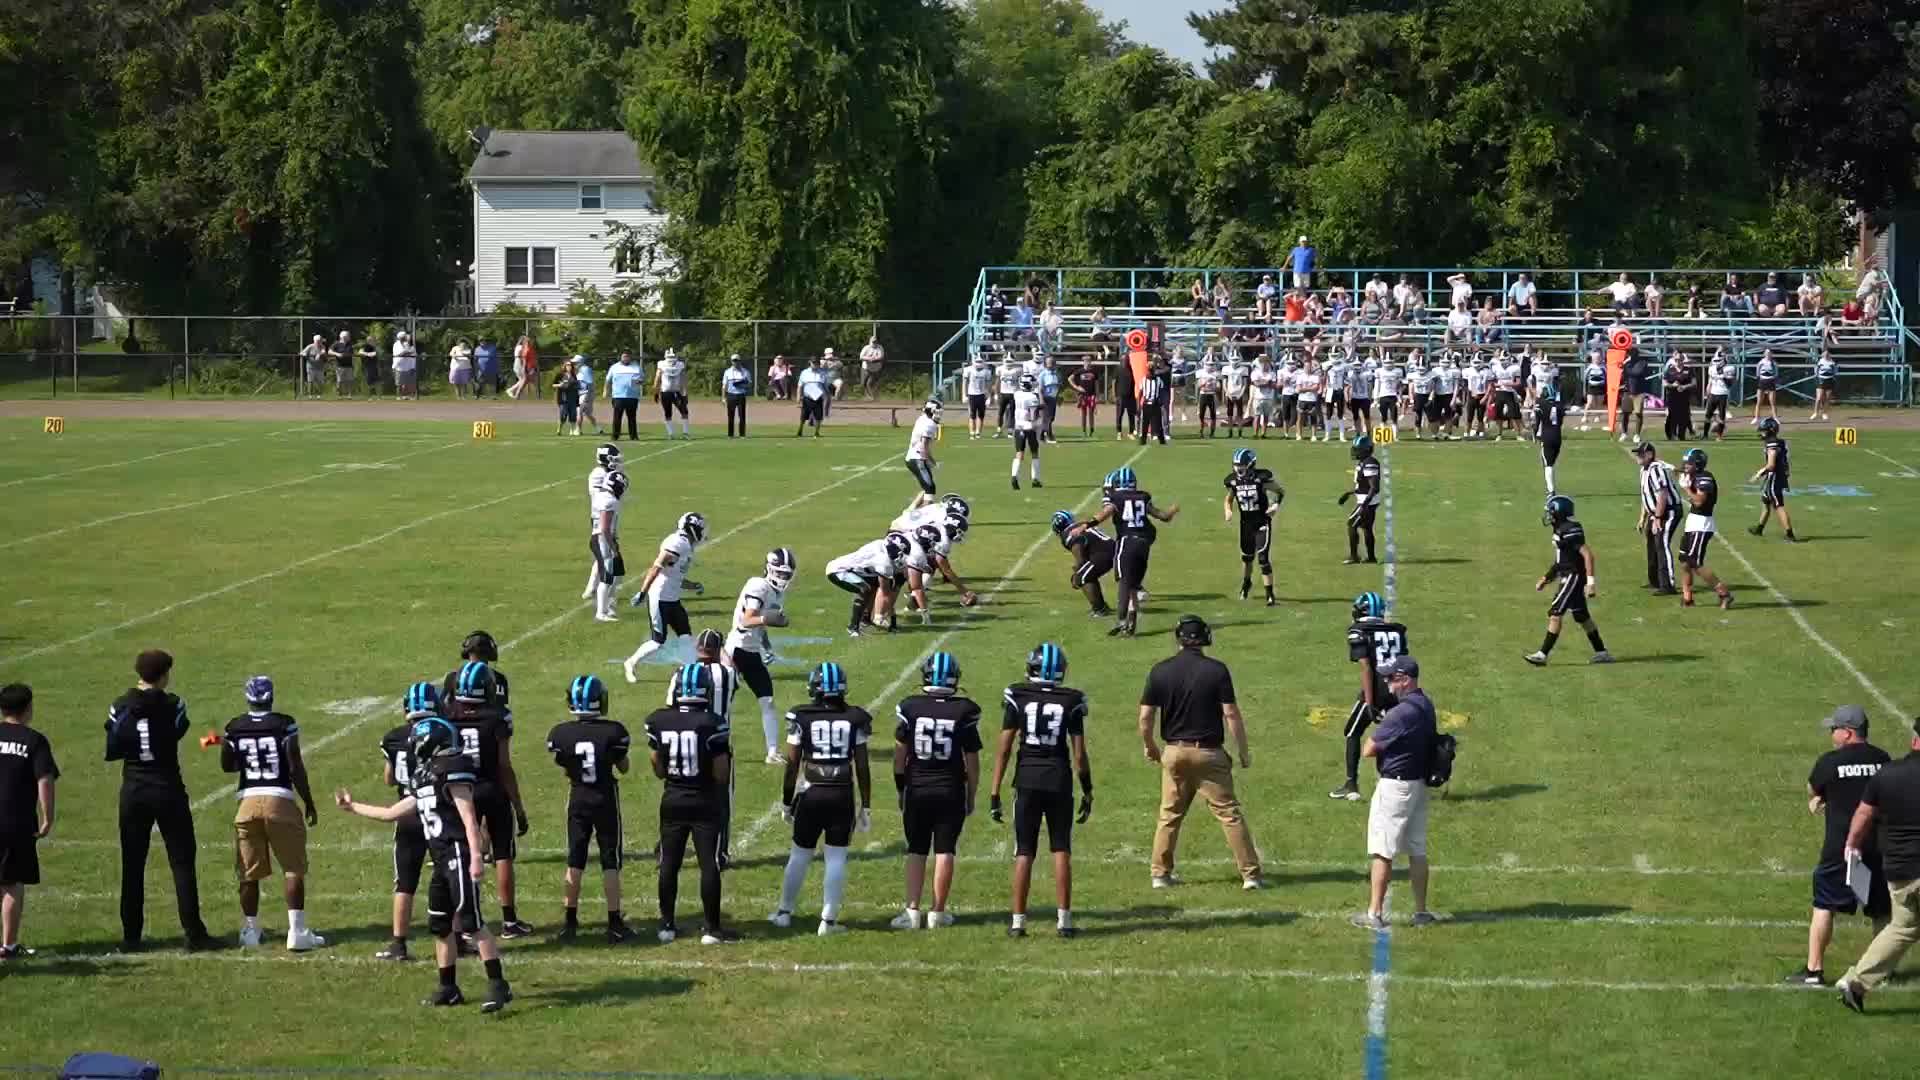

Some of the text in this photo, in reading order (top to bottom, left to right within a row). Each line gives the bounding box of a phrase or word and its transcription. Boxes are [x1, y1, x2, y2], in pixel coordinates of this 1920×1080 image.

[47, 418, 62, 433] 20
[475, 423, 490, 437] 30
[1375, 427, 1391, 442] 50
[1838, 428, 1855, 444] 40
[1122, 500, 1145, 527] 42
[1374, 631, 1400, 667] 22
[136, 718, 155, 761] 1
[810, 719, 851, 760] 99
[914, 716, 956, 760] 65
[1024, 701, 1064, 746] 13
[0, 741, 28, 758] BALL
[238, 736, 279, 780] 33
[575, 741, 597, 783] 3
[660, 730, 699, 777] 70
